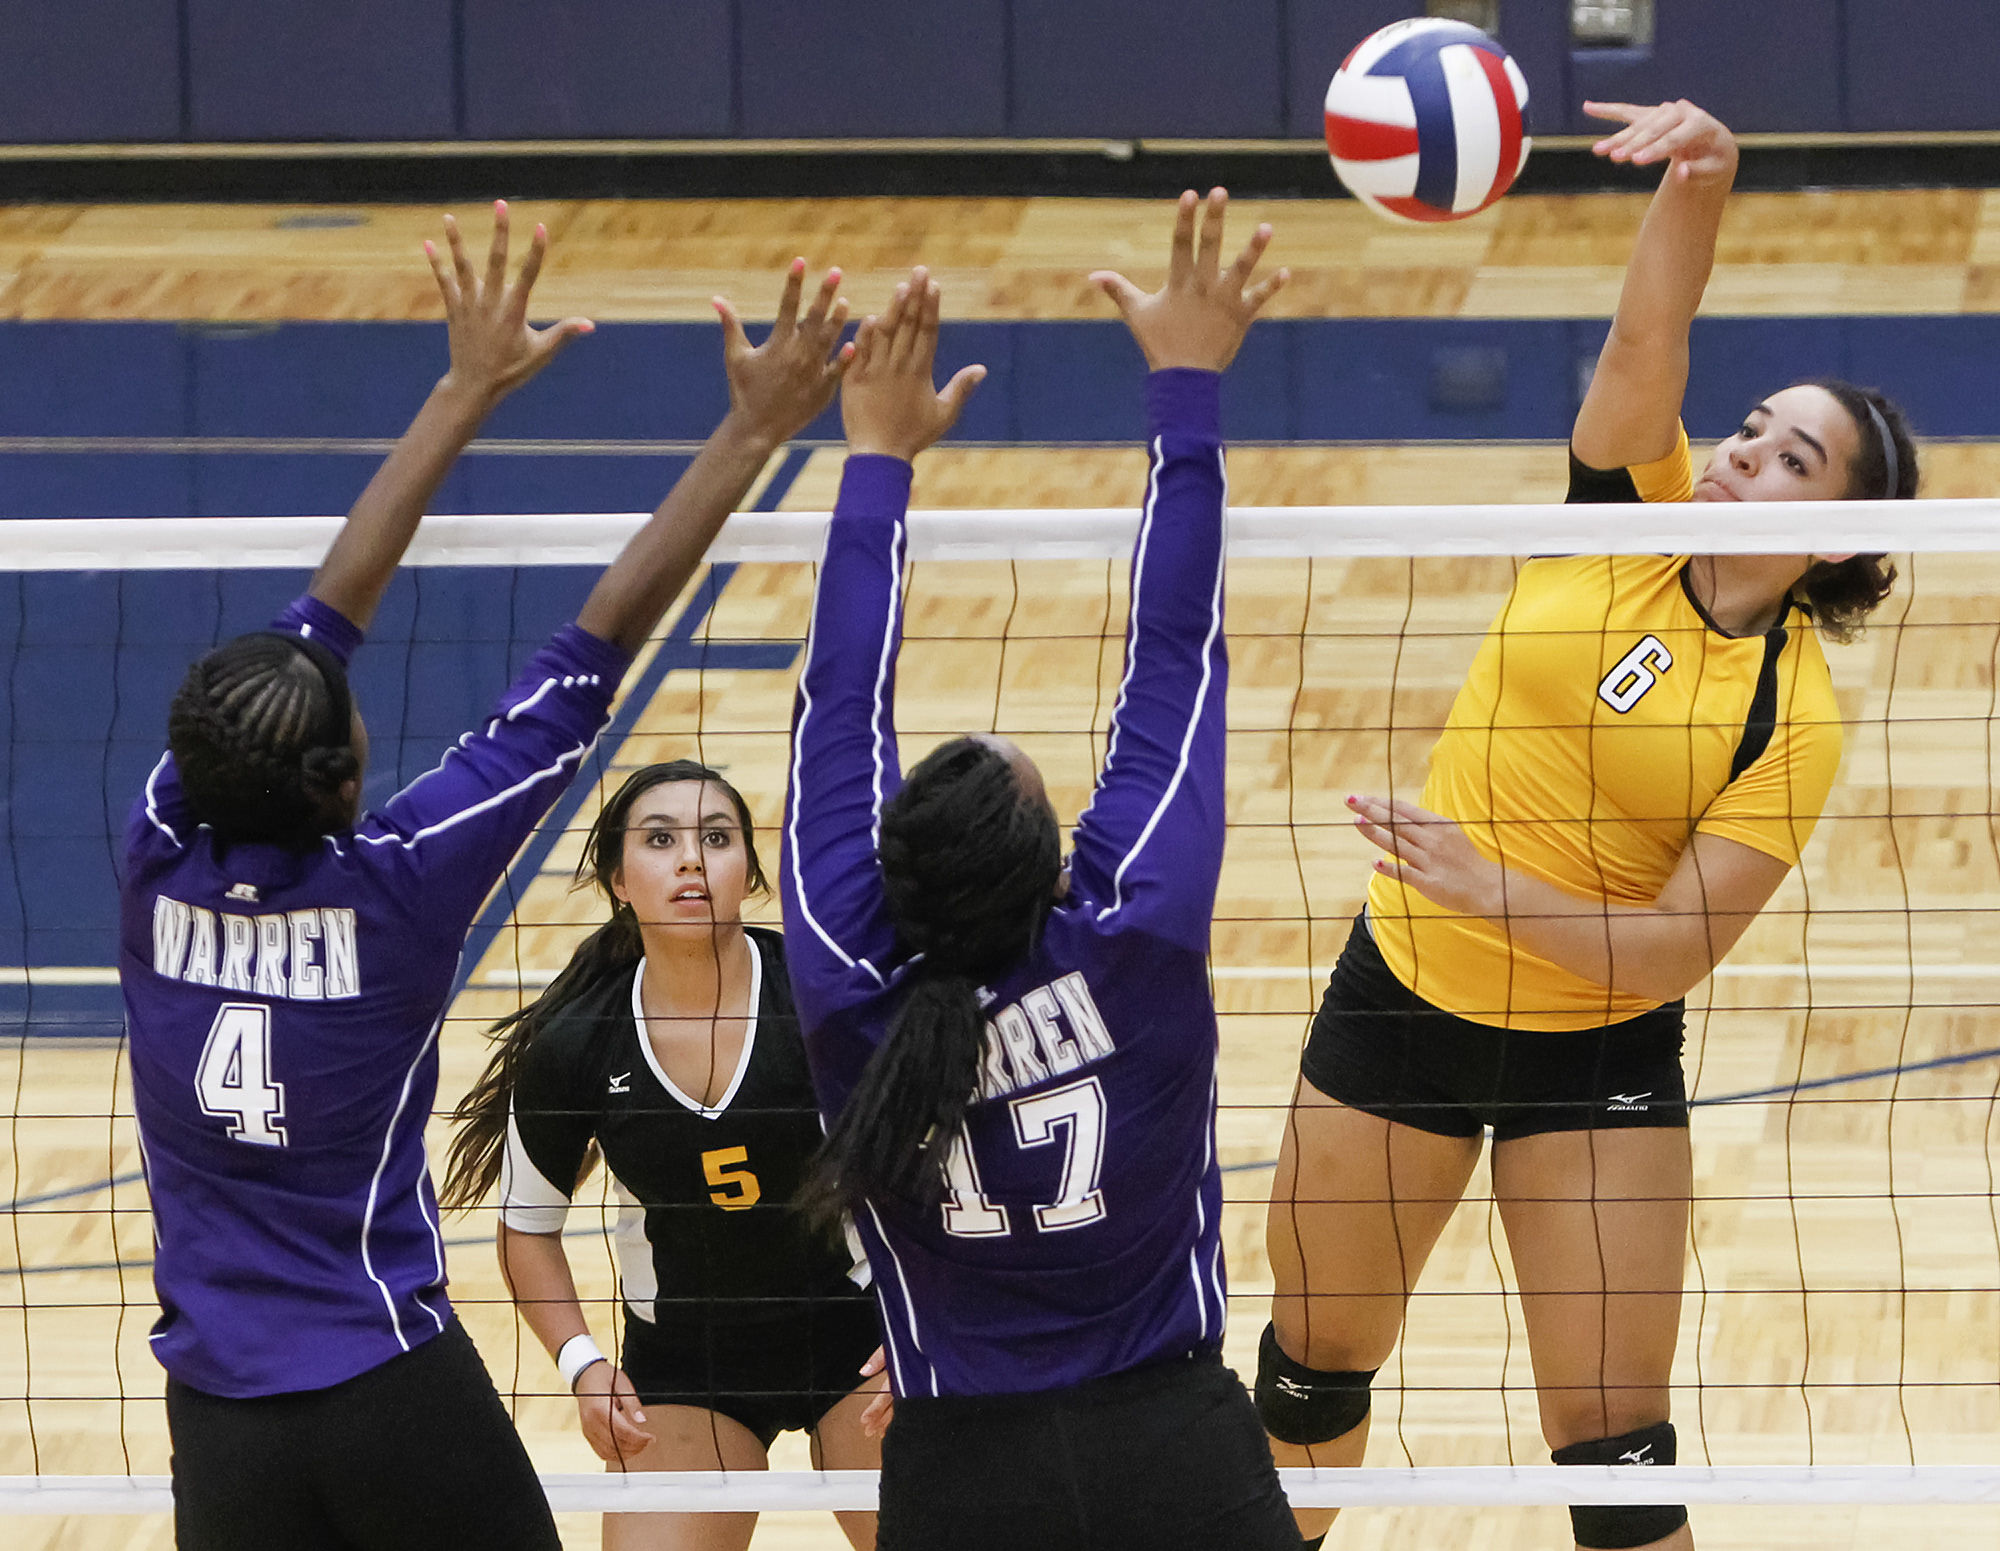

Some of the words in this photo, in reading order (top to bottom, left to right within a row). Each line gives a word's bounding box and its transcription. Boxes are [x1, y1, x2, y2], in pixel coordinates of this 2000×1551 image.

[1597, 634, 1673, 714] 6
[153, 894, 361, 1000] WARREN
[194, 1002, 289, 1148] 4
[967, 970, 1116, 1105] RREN
[701, 1145, 761, 1212] 5
[919, 1075, 1108, 1238] 17
